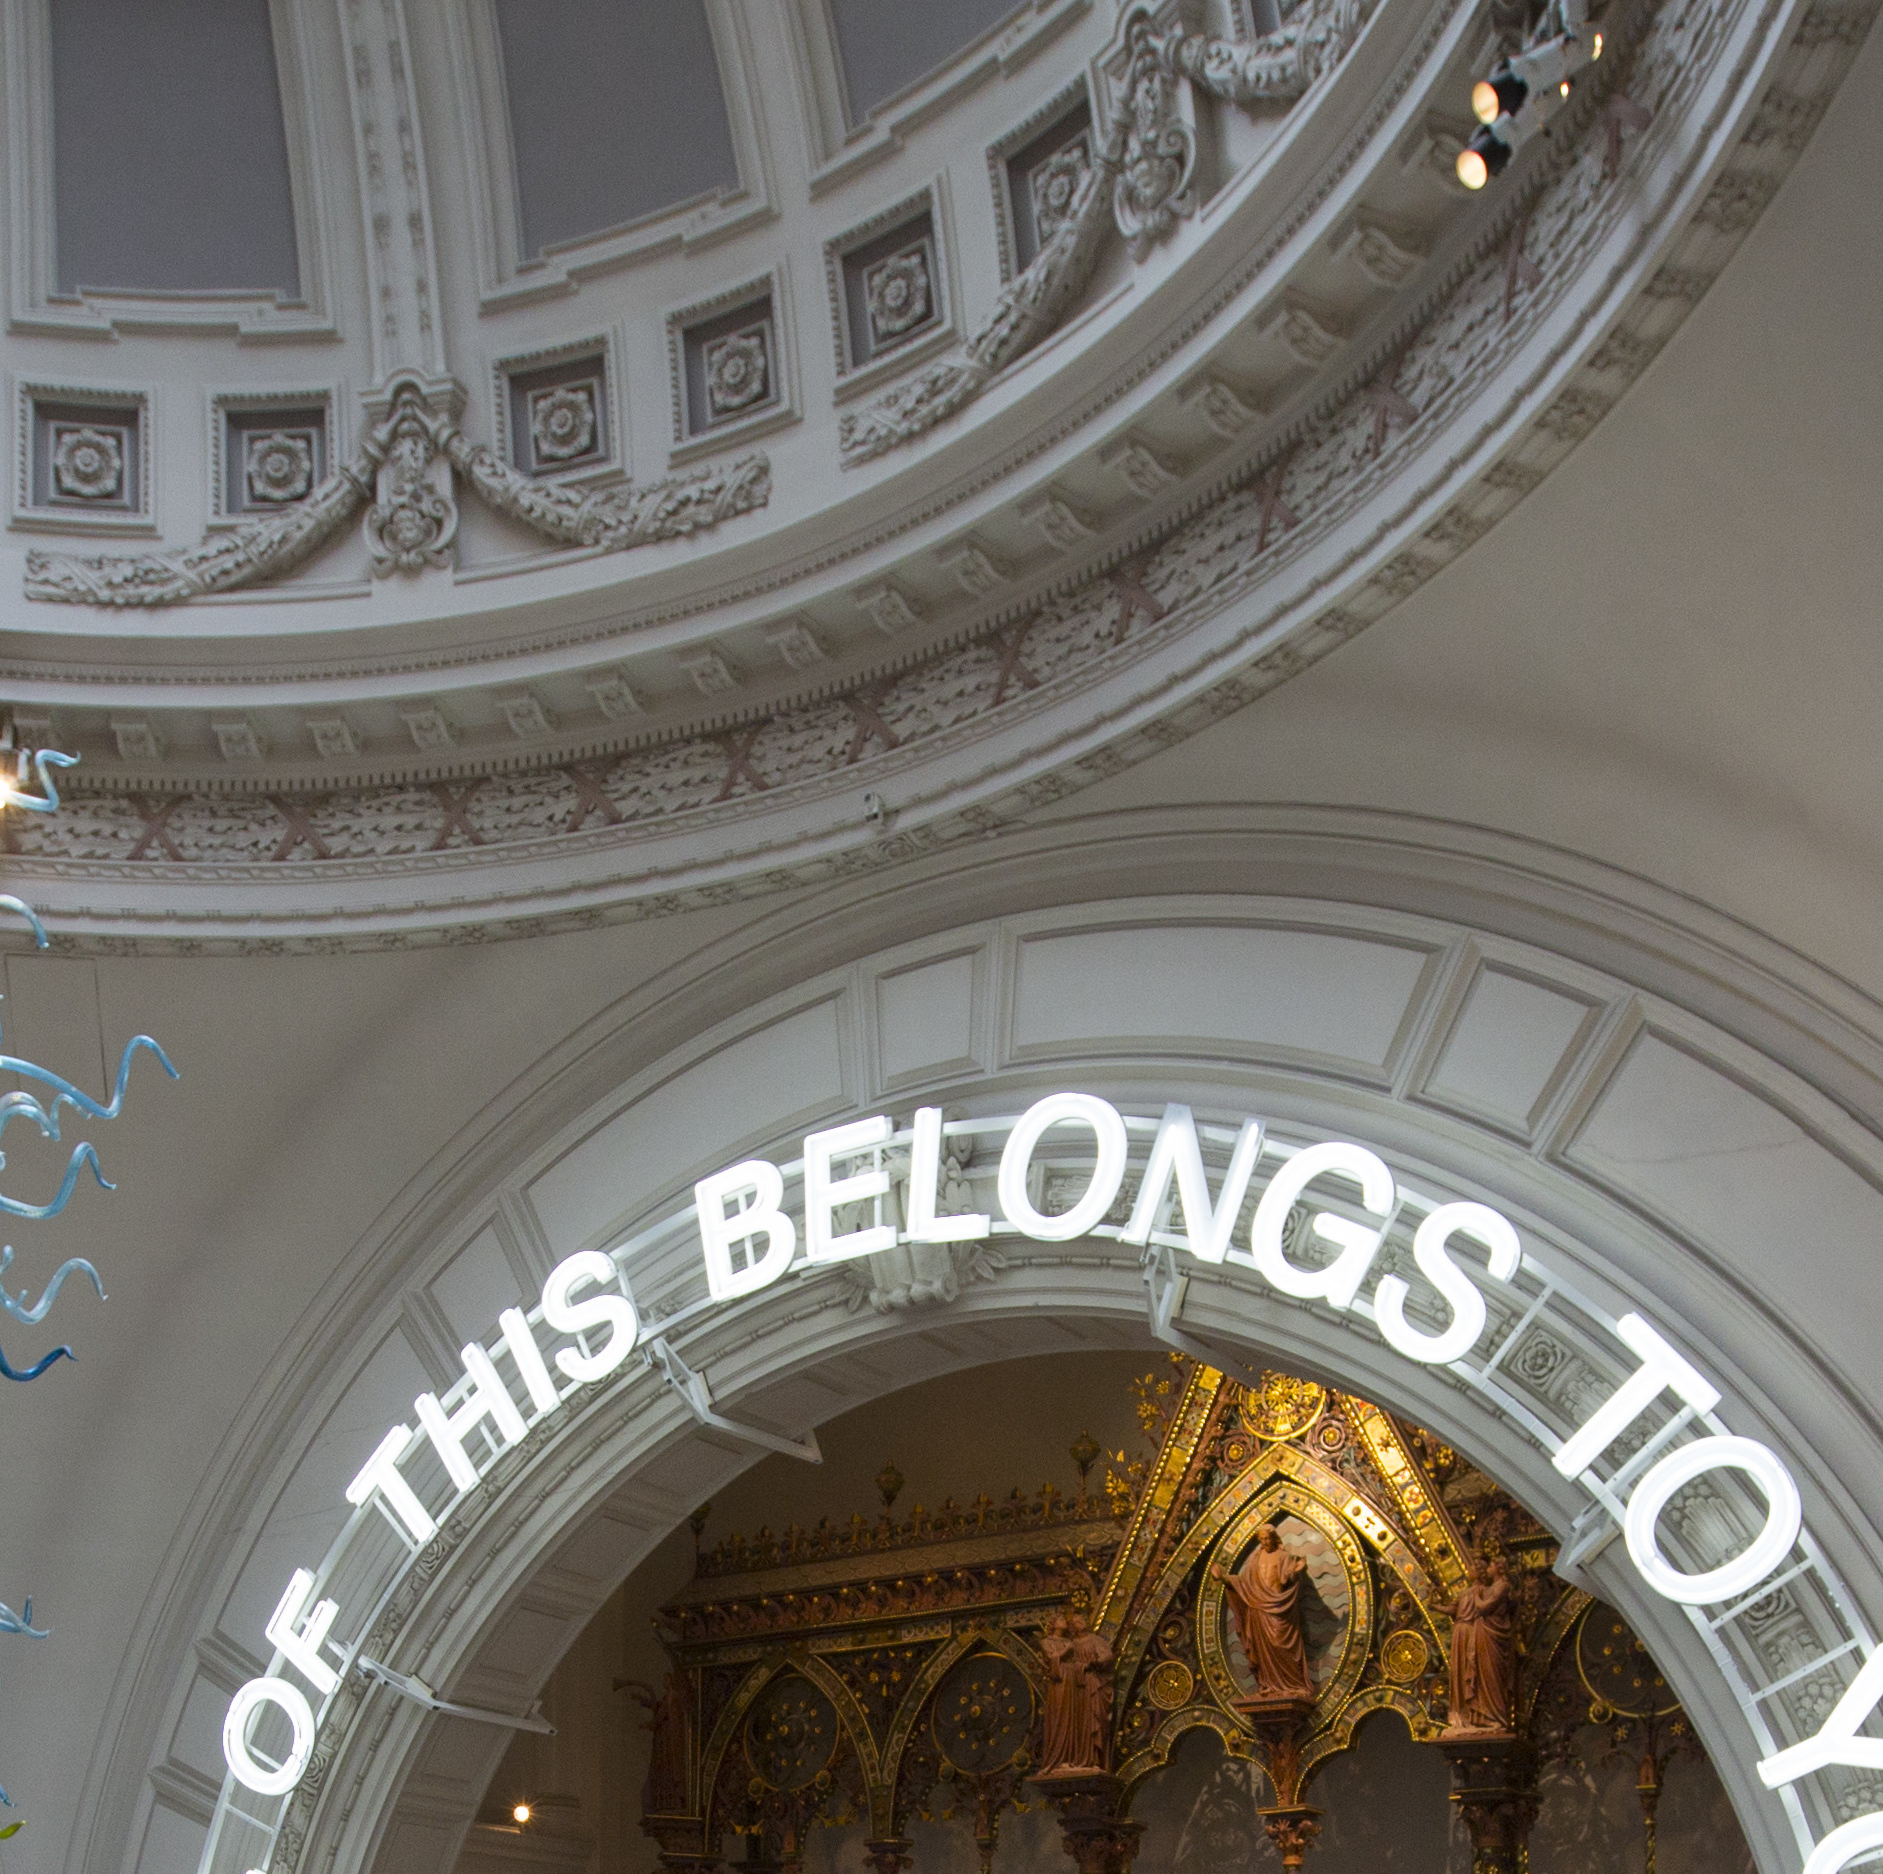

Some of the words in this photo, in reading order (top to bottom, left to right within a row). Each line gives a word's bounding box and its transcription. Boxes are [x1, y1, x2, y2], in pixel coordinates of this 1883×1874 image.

[221, 1567, 341, 1796] OF
[344, 1249, 640, 1546] THIS
[693, 1091, 1520, 1364] BELONGS
[1550, 1312, 1801, 1606] TO
